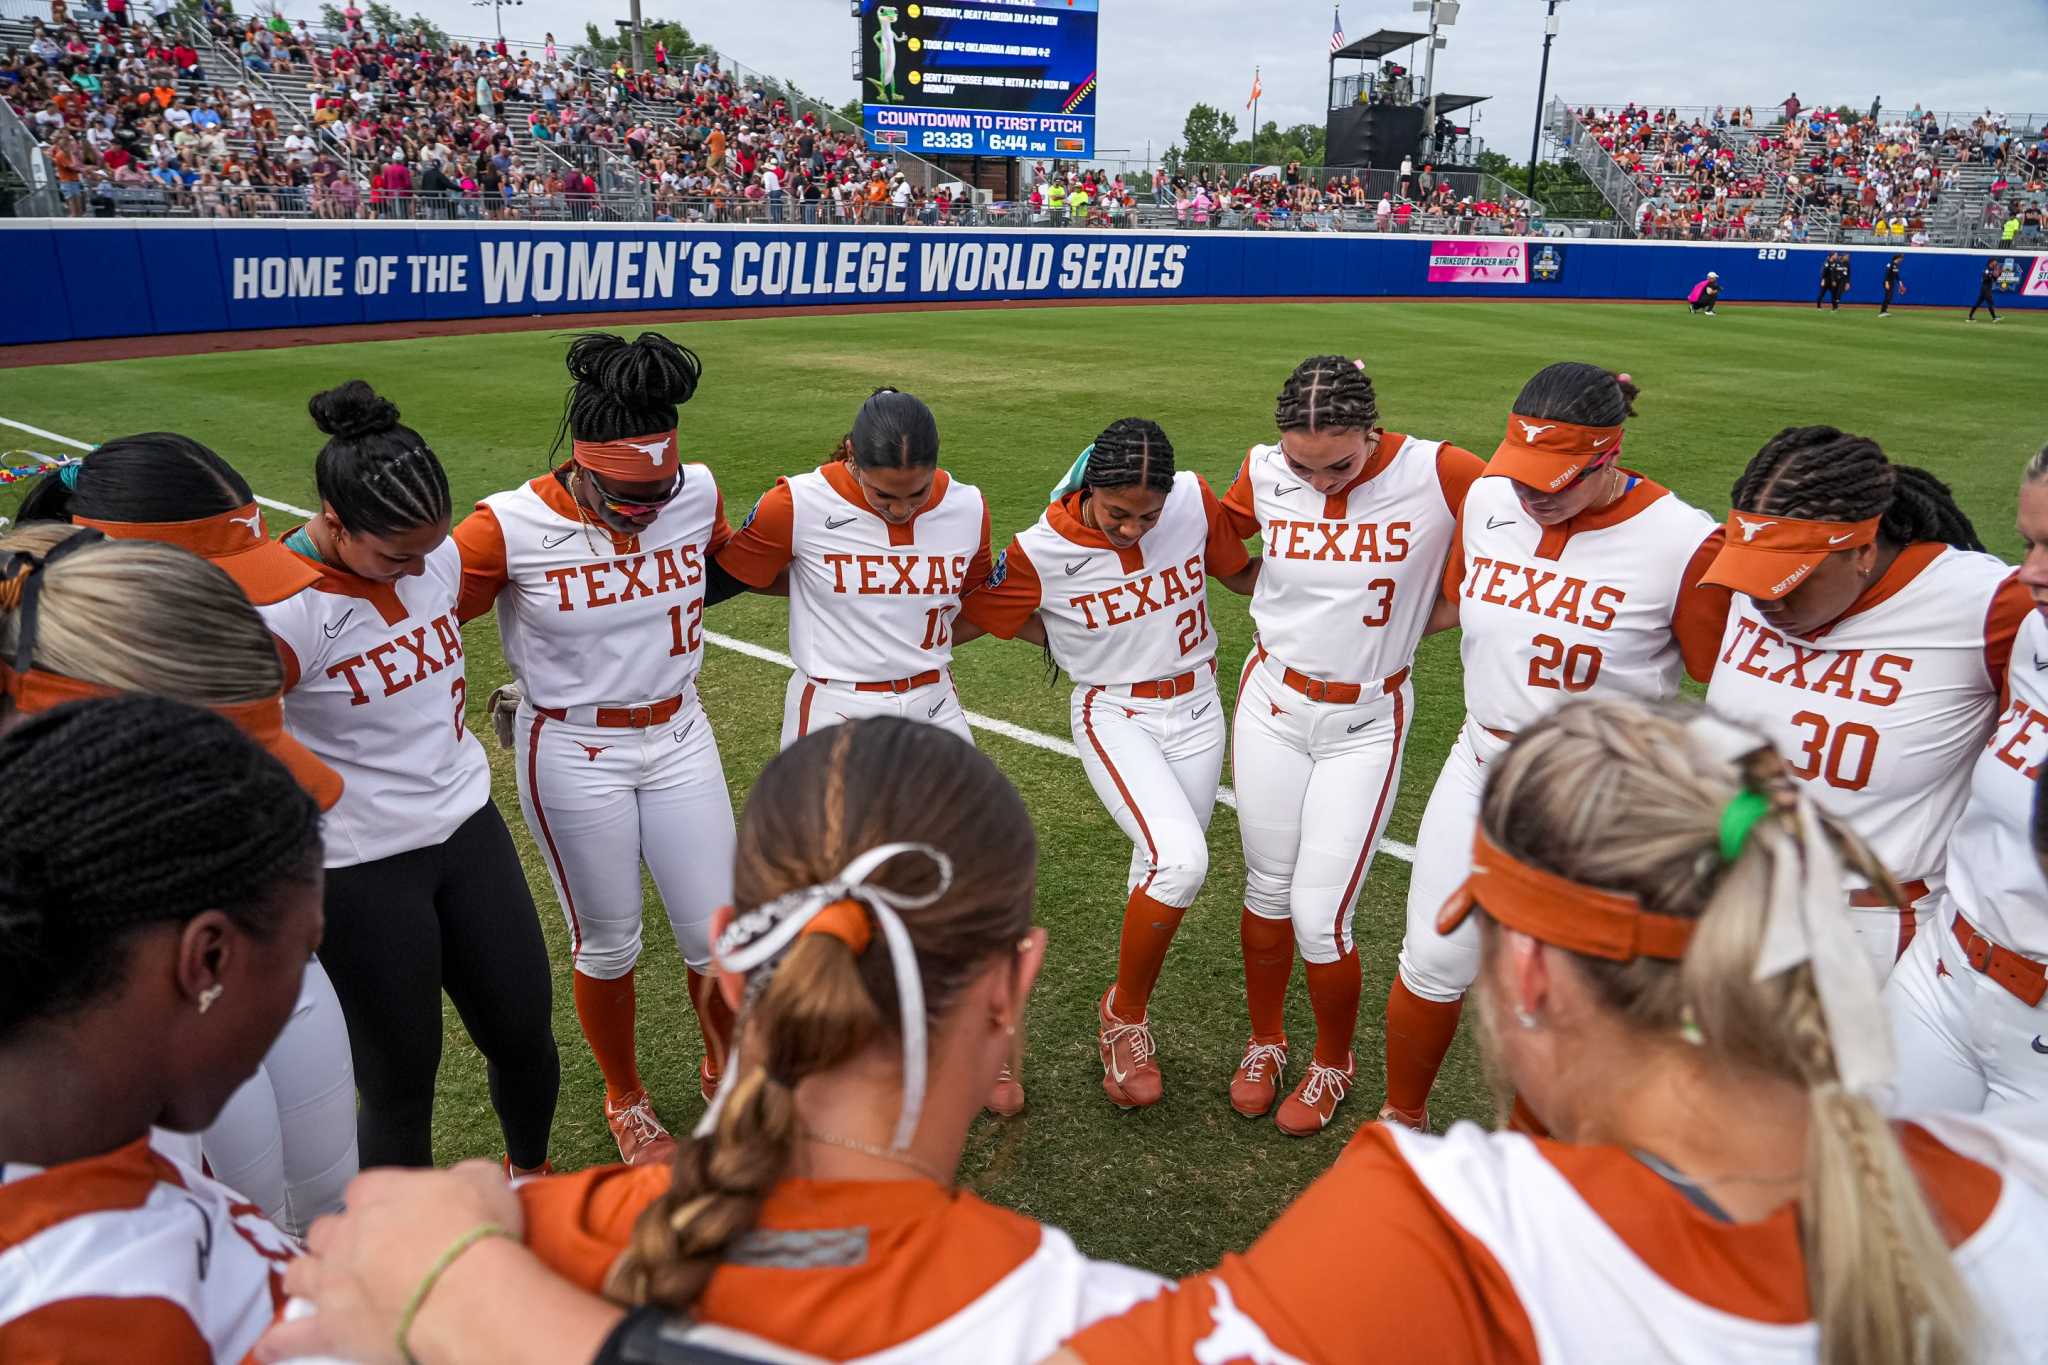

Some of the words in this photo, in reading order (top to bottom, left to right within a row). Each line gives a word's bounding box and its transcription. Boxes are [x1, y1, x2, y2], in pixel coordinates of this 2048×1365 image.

[964, 9, 982, 20] BEAT
[983, 10, 1014, 22] FLORIDA
[922, 39, 942, 50] TOOK
[943, 41, 954, 51] ON
[965, 43, 1004, 54] OKLAHOMA
[1004, 45, 1020, 55] AND
[1021, 46, 1037, 56] WON
[922, 84, 955, 94] MONDAY
[943, 74, 982, 85] TENNESSEE
[983, 76, 1004, 86] HOME
[1005, 78, 1024, 88] WITH
[877, 110, 970, 128] COUNTDOWN
[974, 115, 992, 129] TO
[995, 116, 1037, 131] FIRST
[1040, 119, 1083, 133] PITCH
[922, 131, 973, 149] 23:33
[989, 134, 1027, 151] 6:44
[1031, 142, 1046, 152] PM
[233, 257, 344, 299] HOME
[354, 255, 398, 295] OF
[406, 255, 469, 293] THE
[480, 241, 721, 304] WOMEN'S
[730, 241, 910, 296] COLLEGE
[920, 243, 1054, 292] WORLD
[1058, 244, 1187, 289] SERIES
[1434, 256, 1470, 265] STRIKEOUT
[1471, 257, 1497, 266] CANCER
[1499, 258, 1518, 266] NIGHT
[1758, 248, 1787, 260] 220
[1549, 464, 1579, 489] SOFTBALL
[1268, 520, 1411, 563] TEXAS
[545, 544, 703, 611] TEXAS
[824, 554, 966, 594] TEXAS
[1069, 554, 1204, 629] TEXAS
[1465, 556, 1626, 631] TEXAS
[1771, 563, 1811, 594] SOFTBALL
[1362, 578, 1396, 627] 3
[666, 596, 704, 657] 12
[1175, 599, 1209, 656] 21
[325, 607, 464, 706] TEXA
[1528, 633, 1603, 693] 20
[1722, 616, 1914, 707] TEXAS
[1787, 710, 1880, 791] 30
